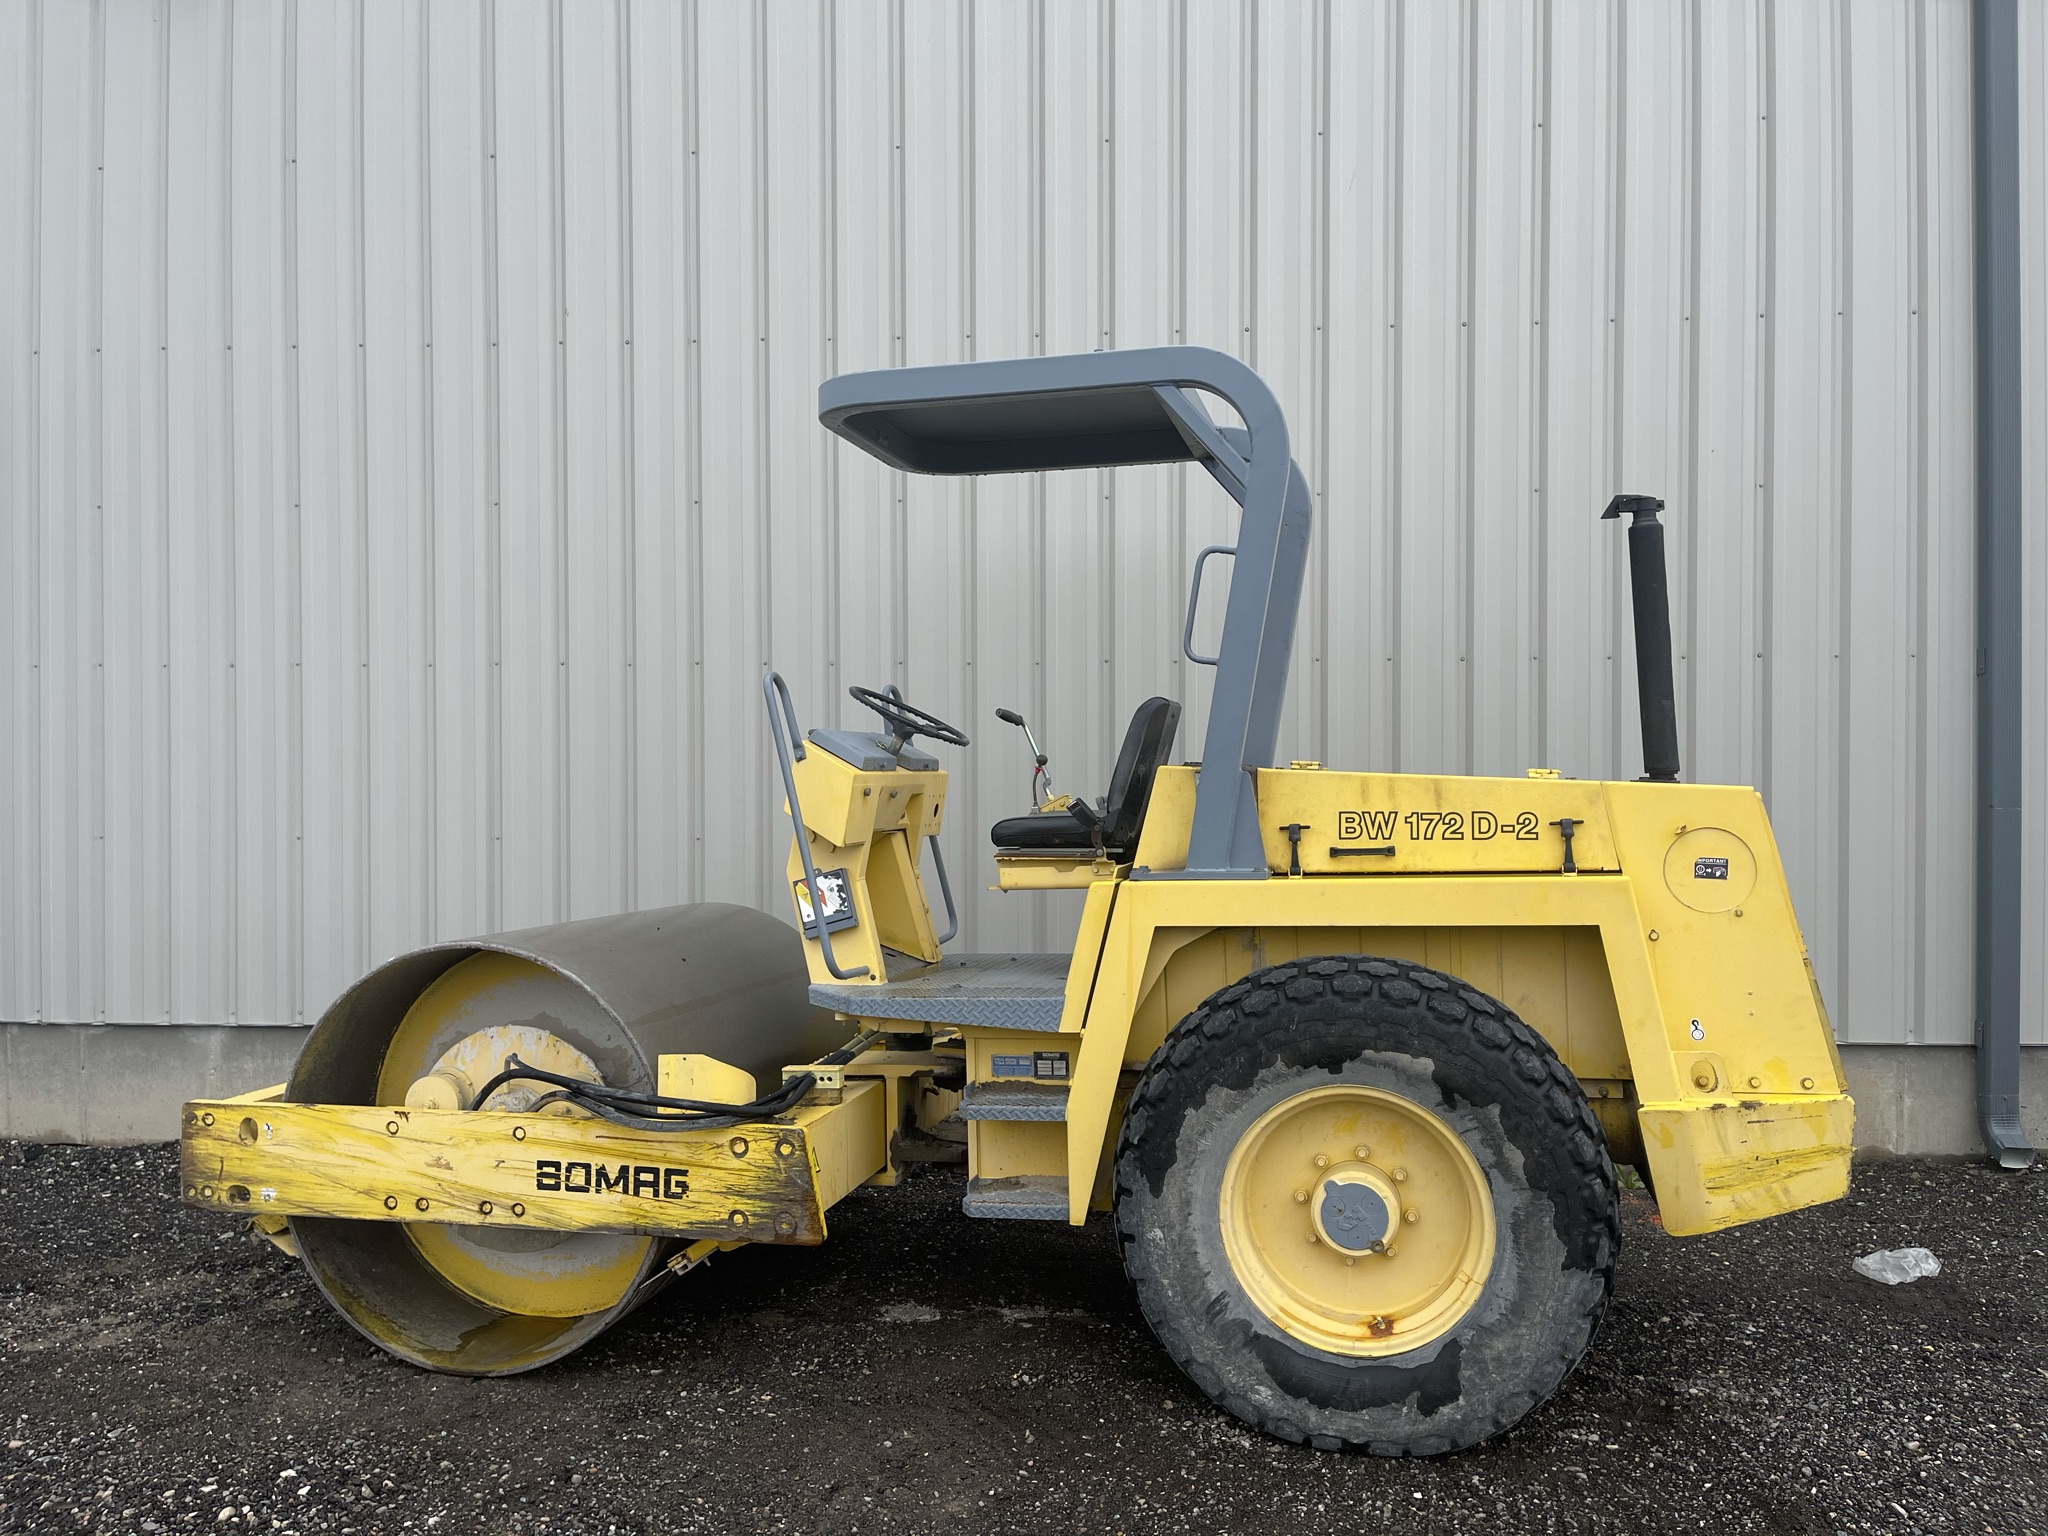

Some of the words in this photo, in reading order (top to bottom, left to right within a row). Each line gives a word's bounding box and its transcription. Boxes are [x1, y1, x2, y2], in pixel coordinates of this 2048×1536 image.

[1338, 811, 1398, 840] BW
[1404, 811, 1464, 841] 172
[1471, 811, 1539, 841] D-2
[536, 1159, 690, 1200] BOMAG
